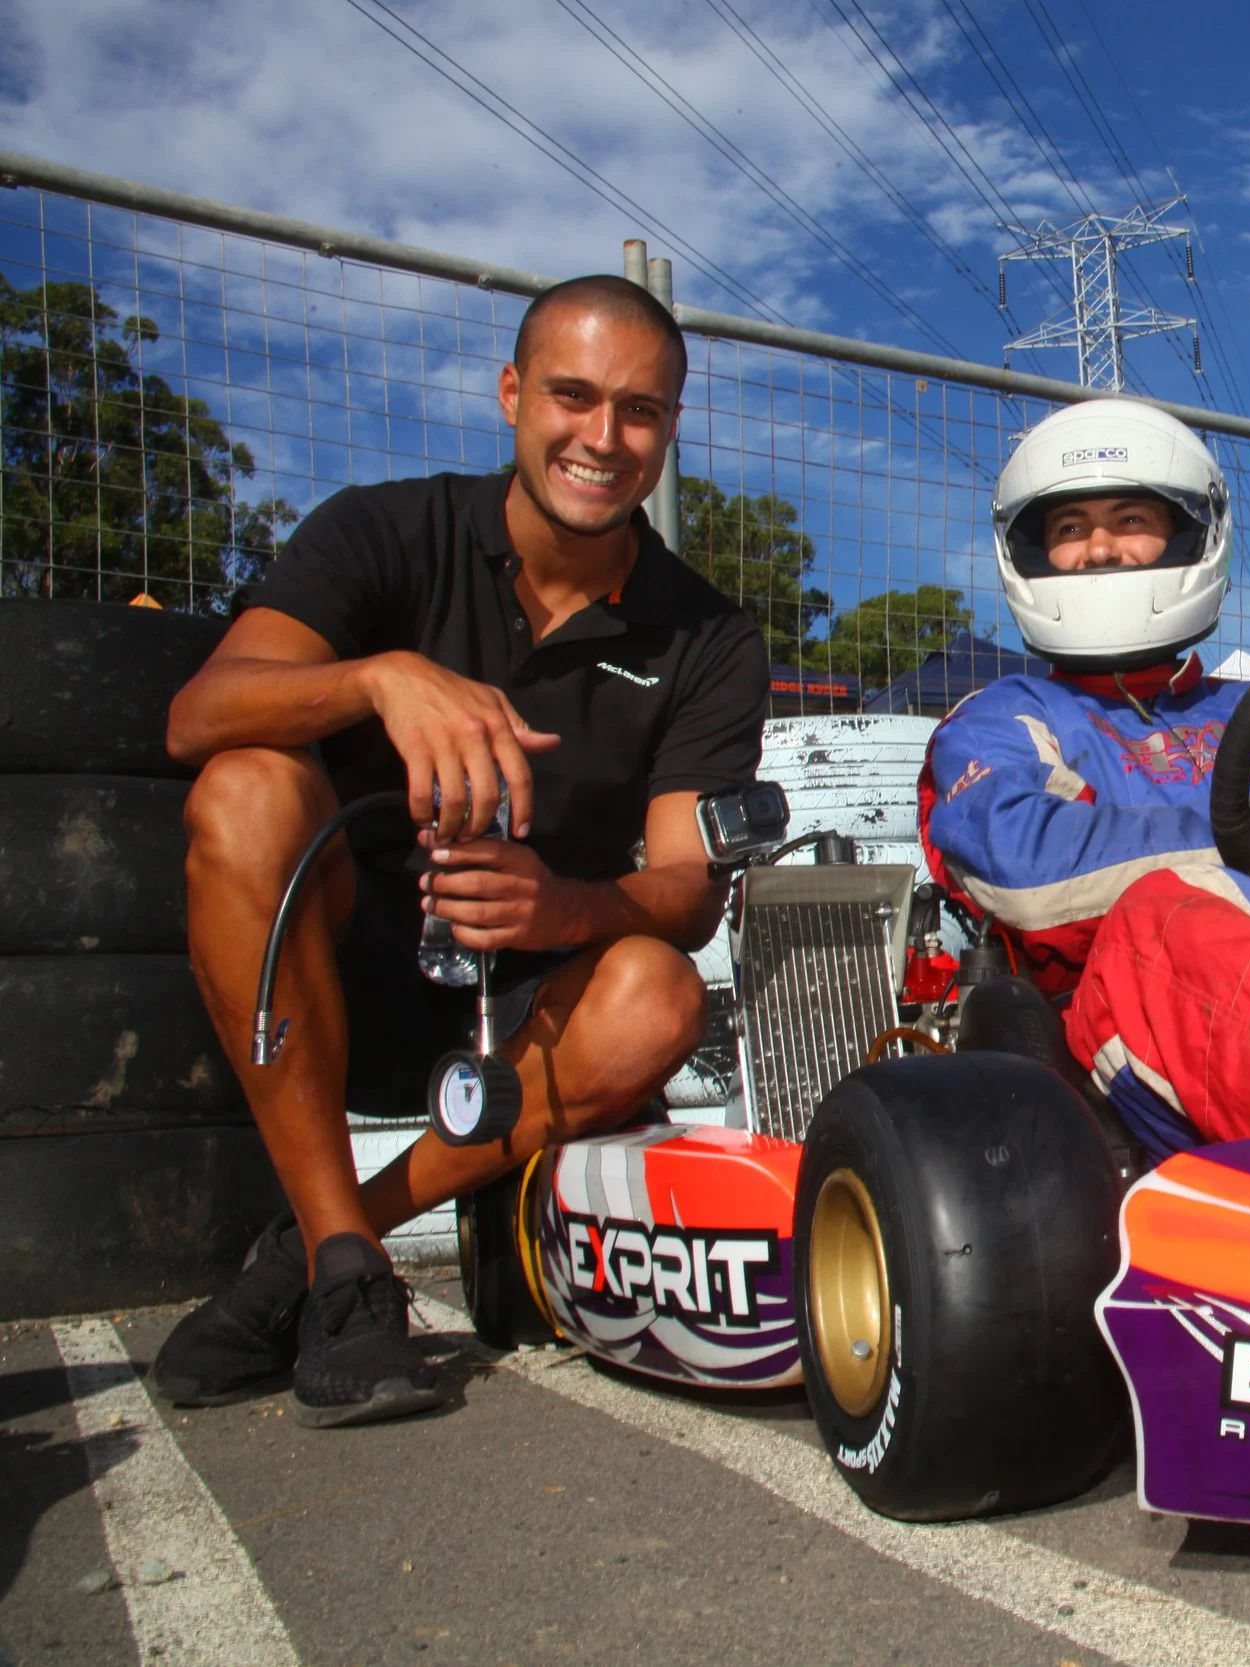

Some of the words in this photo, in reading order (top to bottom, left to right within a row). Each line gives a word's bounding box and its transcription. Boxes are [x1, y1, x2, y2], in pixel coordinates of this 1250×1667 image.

[1063, 448, 1127, 466] sparco
[597, 662, 660, 687] McLaren
[567, 1220, 770, 1316] EXPRIT
